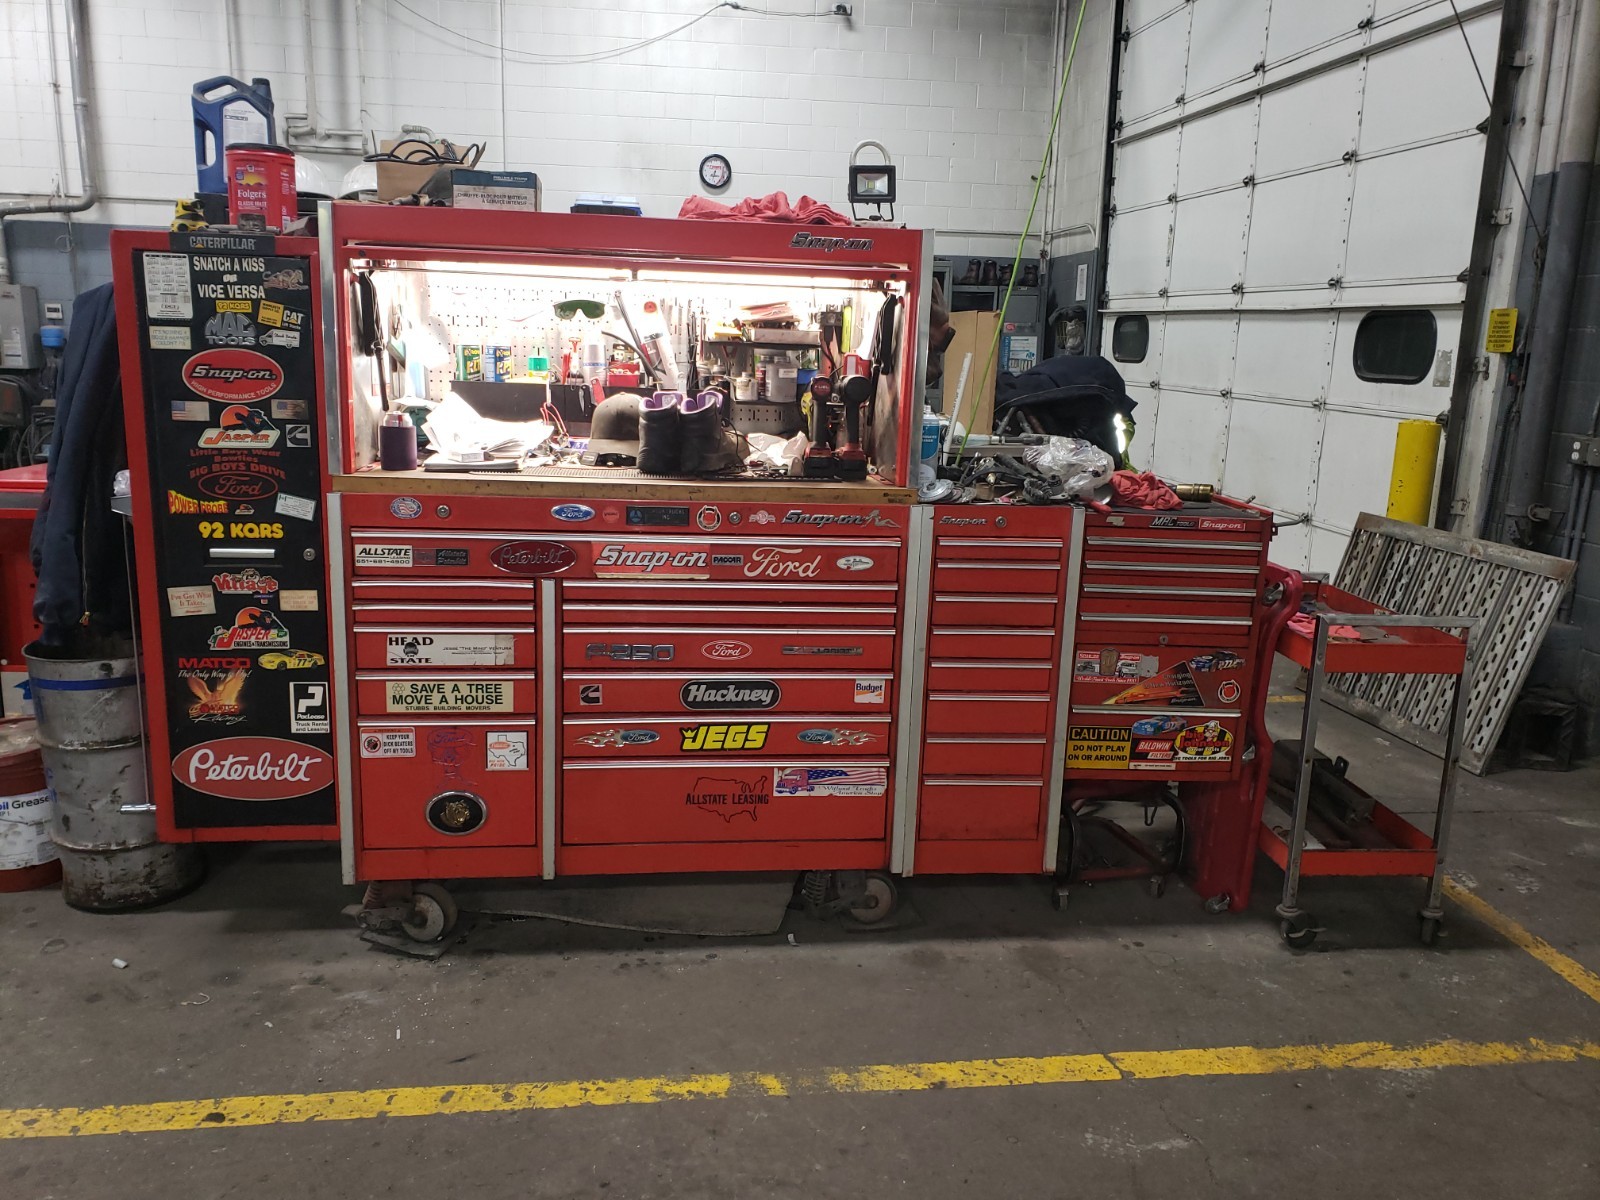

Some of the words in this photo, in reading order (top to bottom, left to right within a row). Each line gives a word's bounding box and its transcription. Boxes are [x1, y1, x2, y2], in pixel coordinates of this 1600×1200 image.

[237, 189, 267, 200] Folgers
[189, 236, 255, 250] CATERPILLAR
[790, 232, 874, 253] Snap-on
[193, 256, 231, 272] SNATCH
[233, 257, 241, 272] A
[242, 257, 265, 272] KISS
[222, 273, 238, 283] OR
[197, 284, 225, 299] VICE
[227, 284, 266, 299] VERSA
[283, 309, 306, 325] CAT
[206, 311, 256, 337] MAC
[205, 336, 256, 346] TOOLS
[191, 364, 277, 383] Snap-on
[190, 380, 207, 393] HIGH
[207, 388, 256, 400] PERFORMANCE
[256, 382, 277, 395] TOOLS
[203, 430, 271, 445] JASPER
[190, 448, 218, 457] Little
[251, 449, 281, 457] Wear
[213, 455, 259, 463] Bowties
[189, 465, 208, 480] BIG
[211, 462, 247, 472] BOYS
[250, 463, 287, 480] DRIVE
[214, 475, 263, 496] Ford
[167, 489, 199, 515] POWER
[200, 500, 229, 515] PROBE
[561, 507, 584, 518] Ford
[780, 509, 864, 528] Snap-on
[939, 515, 988, 527] Snap-on
[1151, 516, 1177, 527] MAC
[1201, 520, 1243, 530] Snap-on
[198, 521, 225, 539] 92
[229, 522, 284, 539] KQRS
[358, 547, 412, 556] ALLSTATE
[499, 545, 570, 566] Peterbilt
[595, 544, 708, 572] Snap-on
[712, 555, 742, 565] PACCAR
[743, 546, 822, 578] Ford
[215, 626, 272, 649] JASPER
[388, 636, 434, 646] HEAD
[254, 640, 289, 648] TRANSMISSIONS
[710, 643, 743, 657] Ford
[178, 657, 251, 669] MATCO
[296, 658, 307, 667] 77
[178, 669, 193, 679] The
[192, 669, 210, 681] Only
[210, 669, 227, 681] Way
[410, 683, 446, 694] SAVE
[451, 683, 461, 694] A
[467, 683, 503, 694] TREE
[687, 683, 775, 705] Hackney
[855, 683, 884, 693] Budget
[392, 694, 434, 705] MOVE
[439, 694, 450, 705] A
[454, 694, 504, 705] HOUSE
[626, 731, 651, 742] Ford
[681, 725, 770, 750] JEGS
[804, 731, 828, 742] Ford
[1071, 728, 1129, 742] CAUTION
[1185, 731, 1205, 740] big
[1072, 744, 1084, 752] DO
[1086, 744, 1103, 752] NOT
[1104, 744, 1126, 752] PLAY
[1138, 741, 1171, 751] BALDWIN
[1179, 736, 1230, 749] Johnson
[1094, 754, 1128, 762] AROUND
[188, 748, 323, 784] Peterbilt
[685, 792, 728, 806] ALLSTATE
[731, 793, 770, 806] LEASING
